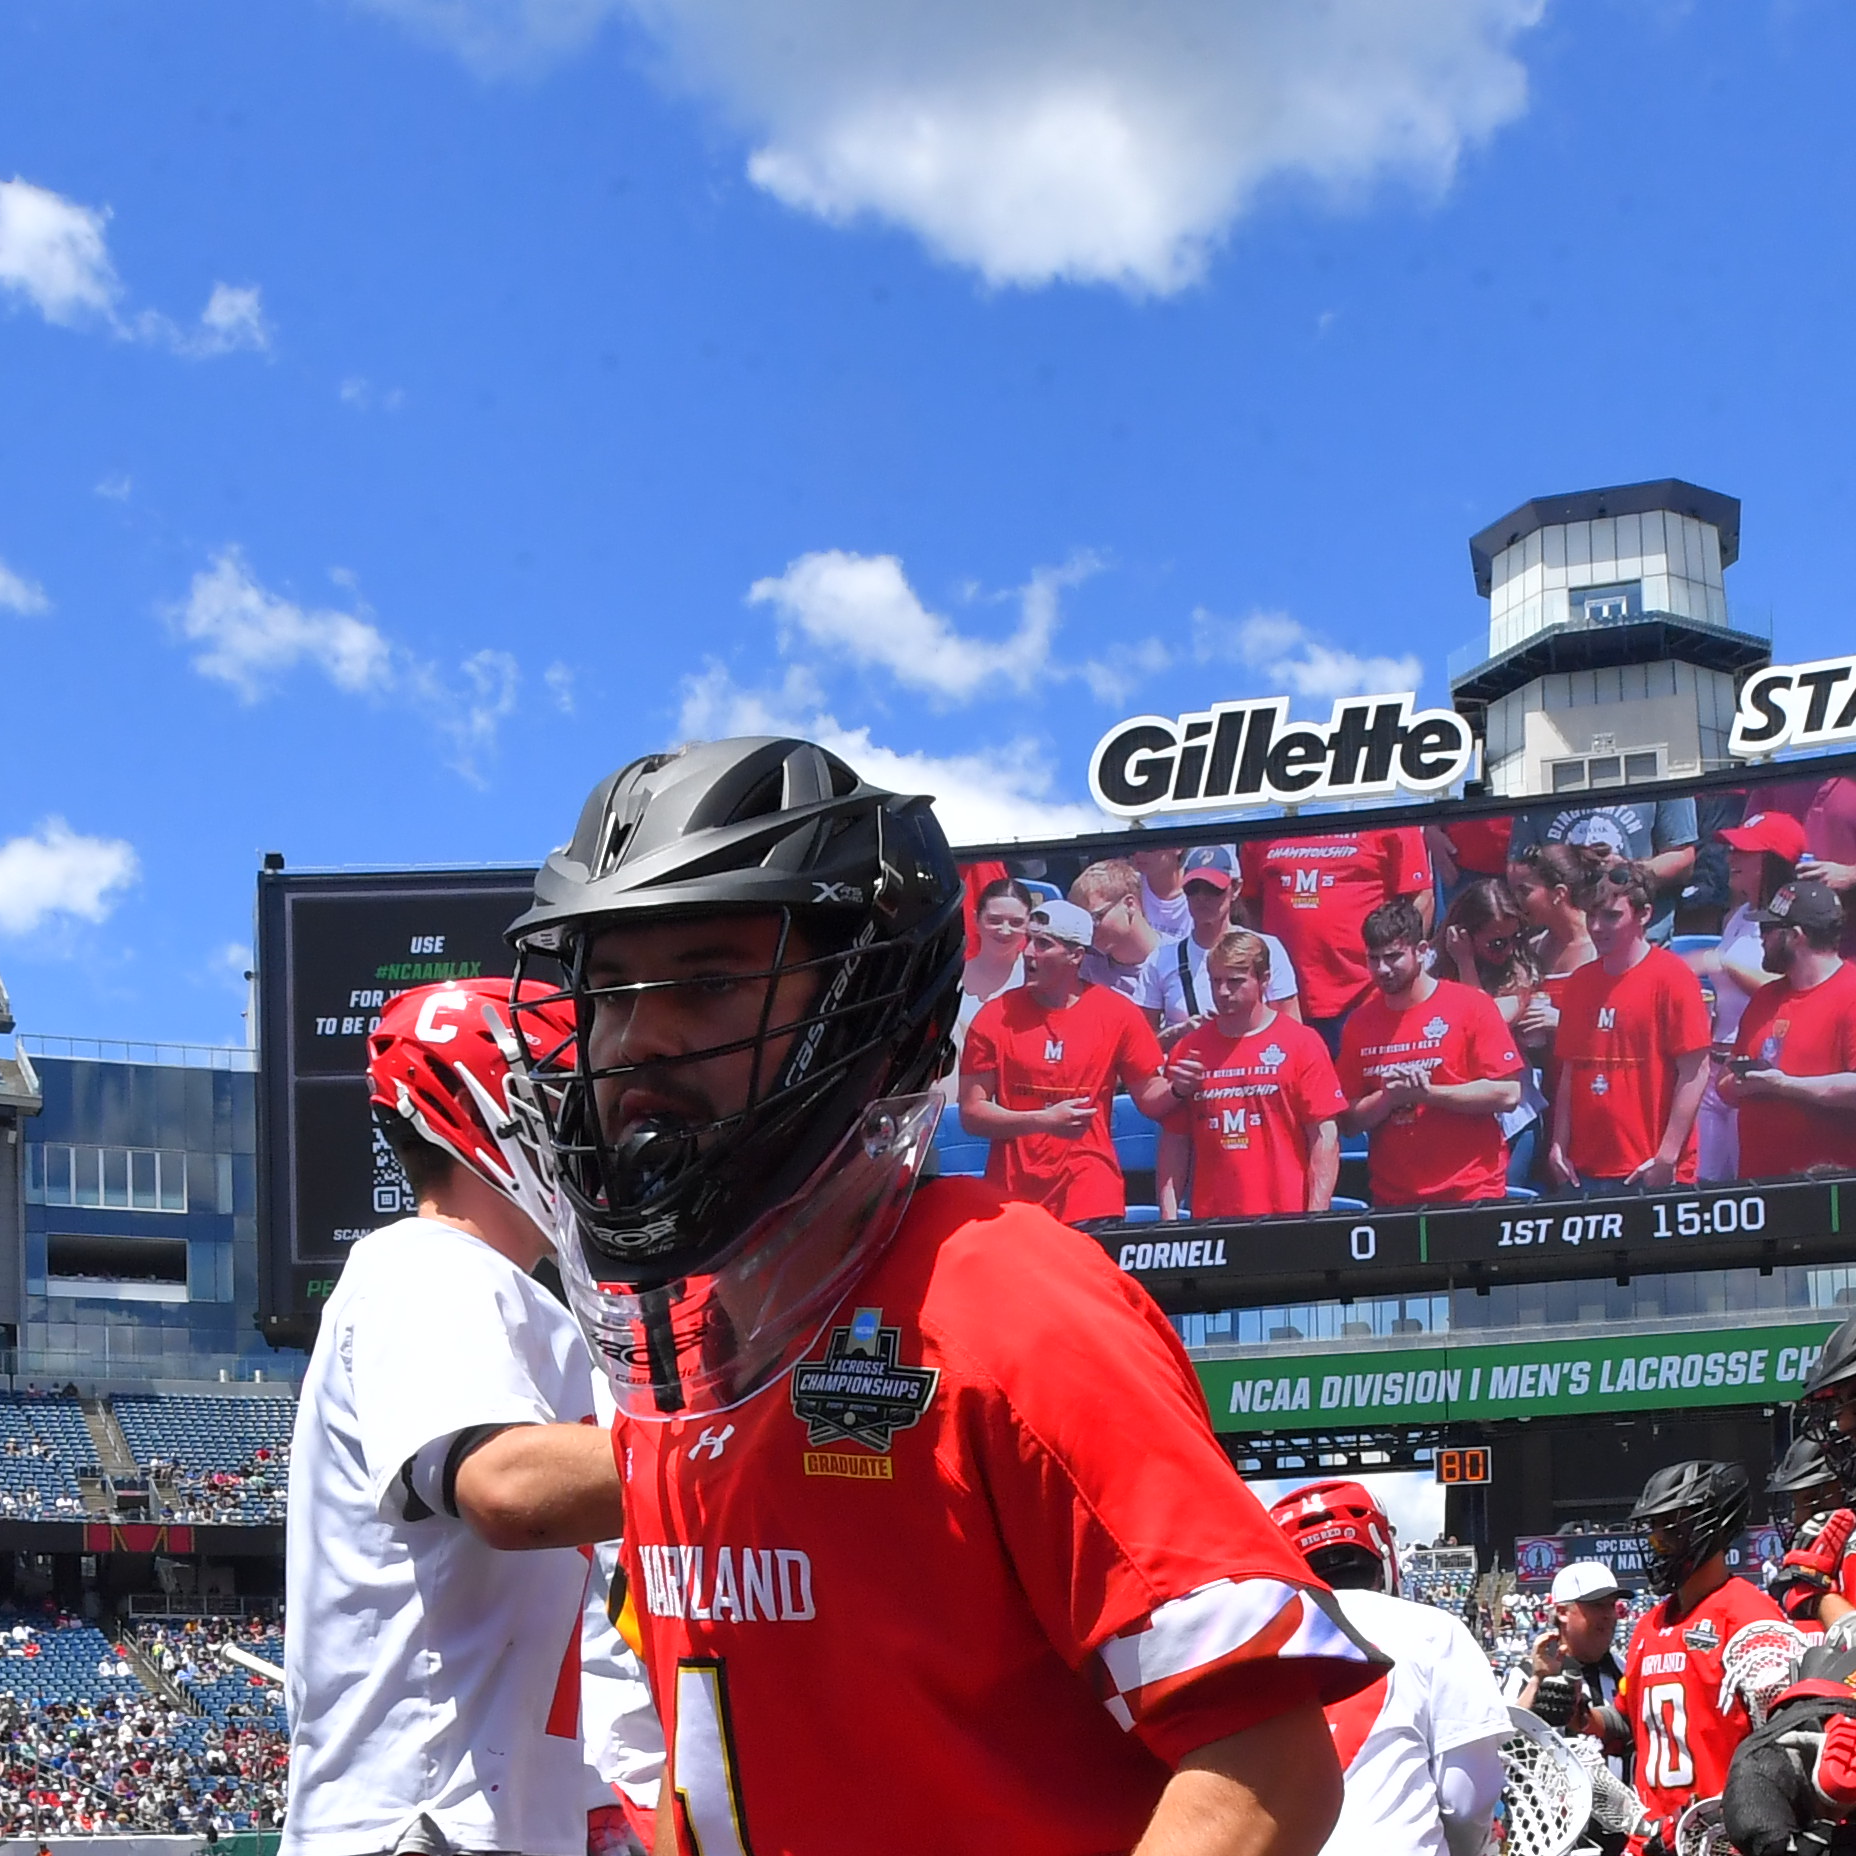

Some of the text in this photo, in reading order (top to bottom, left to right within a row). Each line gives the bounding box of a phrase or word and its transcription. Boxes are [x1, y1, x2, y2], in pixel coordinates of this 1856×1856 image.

[1097, 702, 1462, 807] Gillette
[1266, 845, 1358, 859] CHAMPIONSHIP
[1295, 869, 1320, 893] M
[410, 936, 446, 954] USE
[375, 961, 482, 980] #NCAAMLAX
[350, 990, 383, 1008] FOR
[315, 1017, 339, 1036] TO
[342, 1017, 363, 1035] BE
[414, 989, 467, 1044] C
[1597, 1007, 1616, 1029] M
[1044, 1039, 1064, 1060] M
[1222, 1108, 1246, 1134] M
[1119, 1239, 1227, 1271] CORNELL
[1350, 1226, 1377, 1261] 0
[1498, 1219, 1552, 1248] 1ST
[1561, 1213, 1624, 1243] QTR
[1652, 1198, 1766, 1238] 15:00
[828, 1358, 889, 1377] LACROSSE
[799, 1373, 922, 1402] CHAMPIONSHIPS
[1229, 1377, 1311, 1413] NCAA
[1319, 1366, 1460, 1410] DIVISION
[1468, 1366, 1481, 1399] I
[1488, 1359, 1592, 1400] MEN'S
[1599, 1348, 1769, 1393] LACROSSE
[807, 1454, 890, 1479] GRADUATE
[1442, 1449, 1485, 1483] 80
[1300, 1534, 1321, 1547] BIG
[1596, 1539, 1618, 1553] SPC
[1642, 1651, 1687, 1677] RYLAND
[1643, 1682, 1694, 1788] 10
